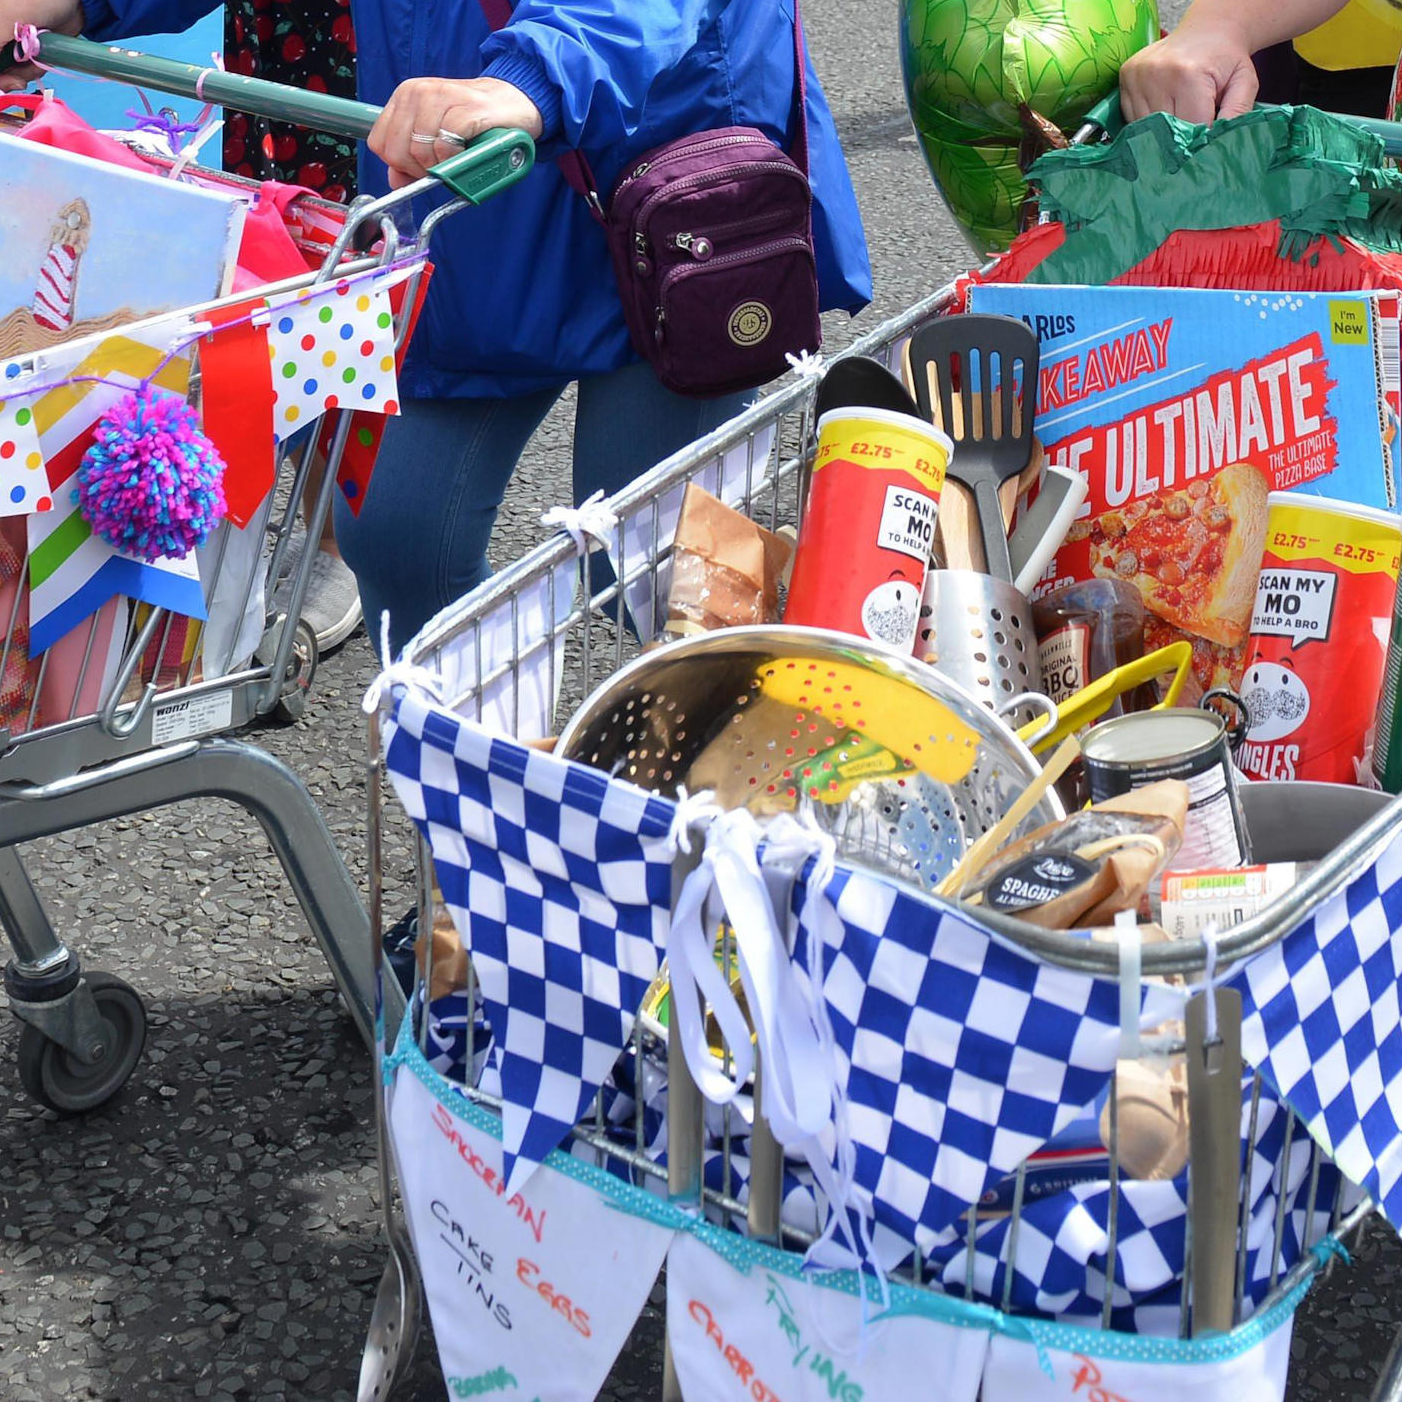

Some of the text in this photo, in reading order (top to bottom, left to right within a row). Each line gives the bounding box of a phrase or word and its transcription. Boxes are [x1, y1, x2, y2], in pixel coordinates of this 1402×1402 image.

[1338, 309, 1356, 321] I'm
[1333, 321, 1364, 336] New
[1032, 316, 1174, 417] KEAWAY
[1105, 347, 1322, 505] ULTIMATE
[850, 442, 893, 459] £2.75
[1267, 431, 1333, 473] THE ULTIMATE
[915, 458, 941, 482] £2.75
[1274, 455, 1328, 488] PIZZA BASE
[893, 494, 930, 519] SCAN
[888, 532, 901, 543] TO
[903, 536, 922, 550] HELP
[907, 515, 932, 543] MO
[1273, 533, 1307, 549] £2.75
[1334, 543, 1376, 563] £2.75
[1259, 575, 1327, 594] SCAN MY
[1263, 593, 1301, 615] MO
[1260, 617, 1282, 628] HELP
[1284, 618, 1292, 628] A
[1294, 618, 1319, 630] BRO
[430, 1200, 494, 1275] CAKE
[439, 1233, 512, 1331] TINS
[516, 1257, 592, 1339] EGGS
